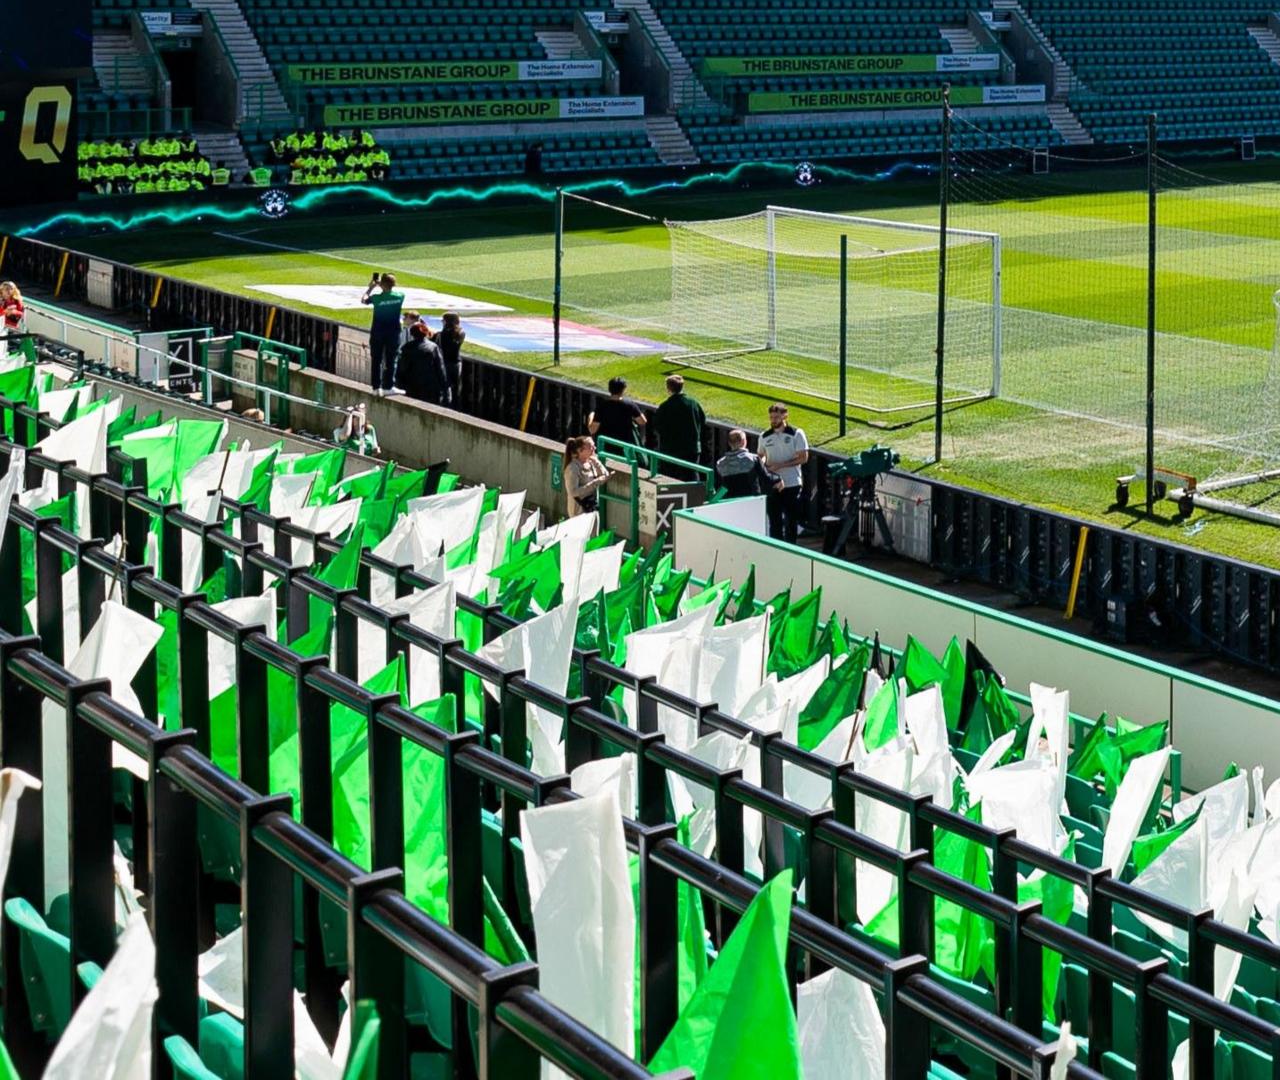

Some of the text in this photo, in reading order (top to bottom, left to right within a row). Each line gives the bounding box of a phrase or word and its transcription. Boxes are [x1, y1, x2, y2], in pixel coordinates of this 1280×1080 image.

[742, 58, 904, 71] THE BRUNSTANE GROUP
[299, 65, 511, 81] THE BRUNSTANE GROUP
[790, 91, 950, 107] THE BRUNSTANE GROU
[337, 103, 551, 121] THE BRUNSTANE GROUP
[568, 107, 605, 115] Specialists
[19, 86, 72, 163] Q
